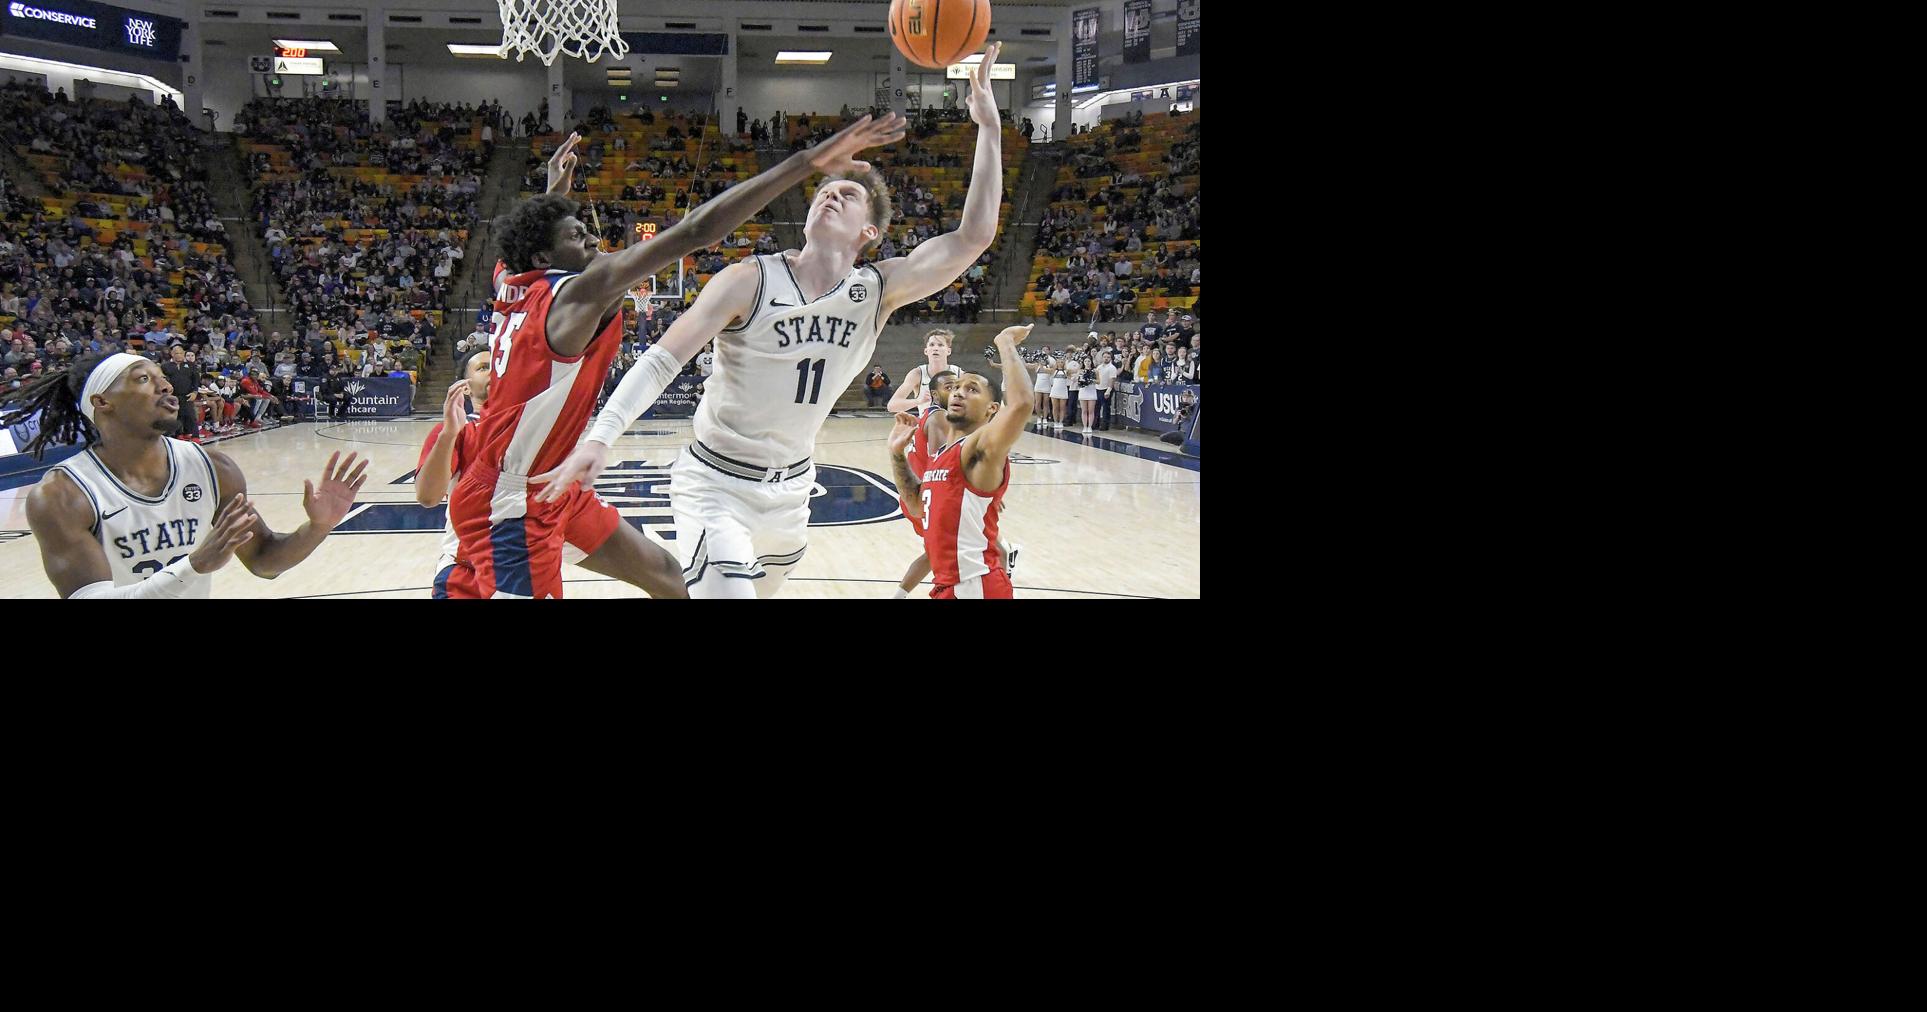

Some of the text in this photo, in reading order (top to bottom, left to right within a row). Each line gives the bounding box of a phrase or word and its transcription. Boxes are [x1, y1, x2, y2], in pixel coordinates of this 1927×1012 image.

[24, 7, 97, 29] CONSERVICE
[128, 18, 153, 31] NEW
[125, 25, 156, 40] YORK
[130, 34, 153, 47] LIFE
[635, 222, 656, 233] 2:00
[852, 290, 866, 300] 33
[773, 315, 857, 348] STATE
[794, 357, 826, 405] 11
[768, 471, 783, 483] A
[185, 490, 200, 500] 33
[114, 518, 198, 559] STATE
